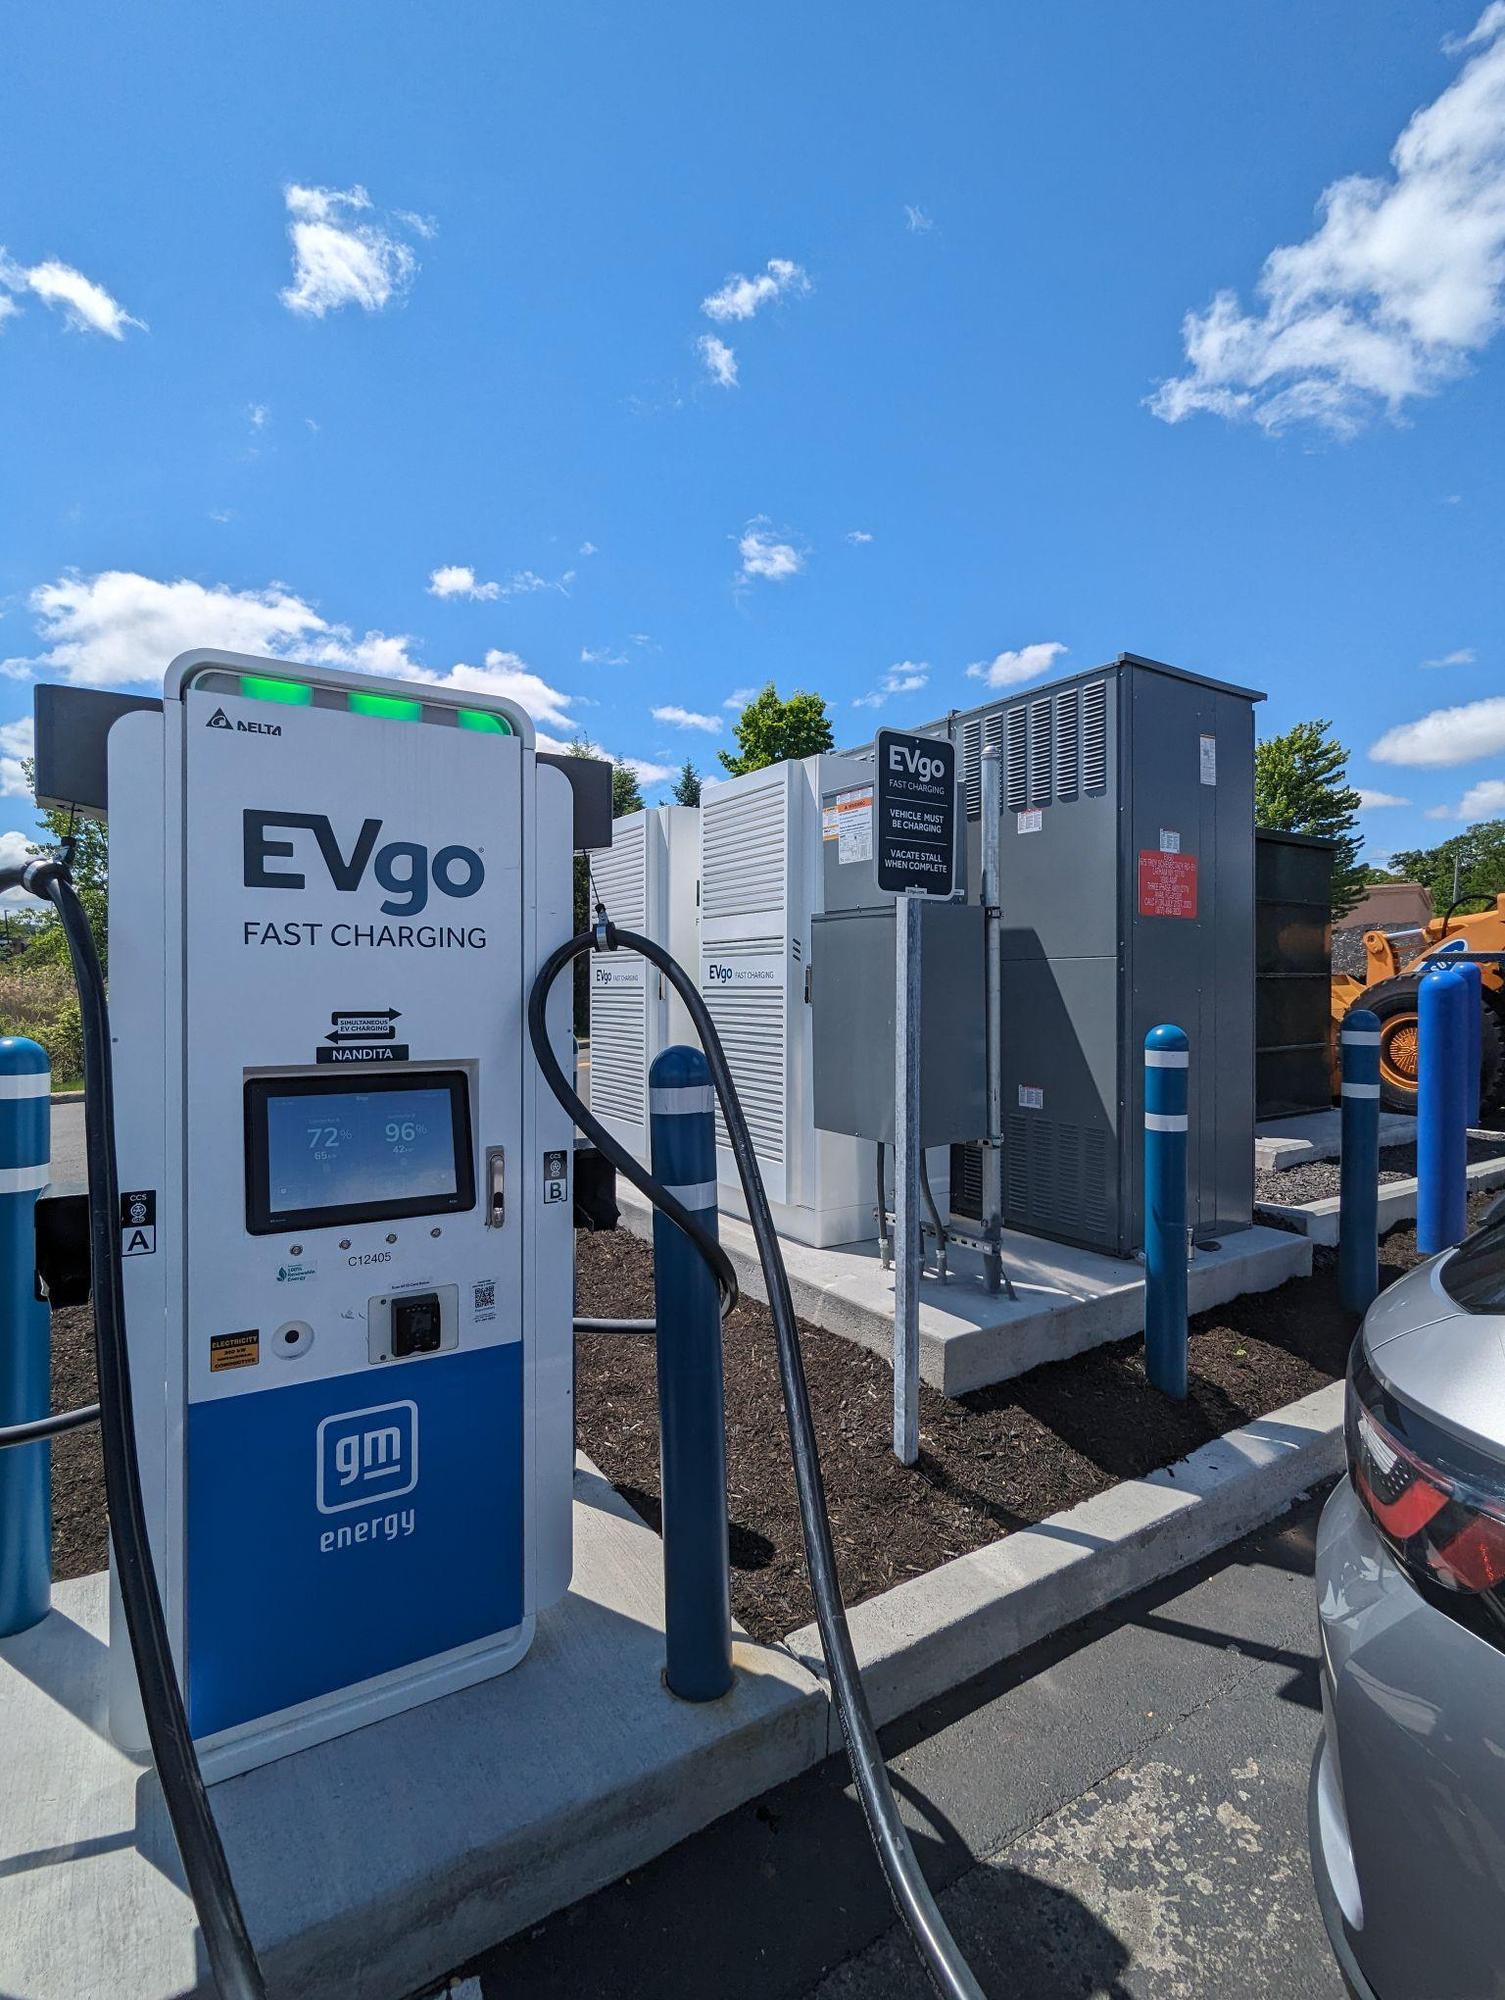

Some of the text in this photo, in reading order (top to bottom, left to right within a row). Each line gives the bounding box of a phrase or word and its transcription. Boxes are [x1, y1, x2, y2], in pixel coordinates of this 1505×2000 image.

[237, 720, 282, 737] DELTA
[888, 744, 945, 782] EVgo
[889, 778, 945, 795] FAST CHARGING
[889, 808, 944, 824] VEHICLE MUST
[892, 819, 942, 834] BE CHARGING
[243, 808, 485, 917] EVgo
[890, 849, 942, 863] VACATE STALL
[885, 858, 948, 873] WHEN COMPLETE
[243, 922, 487, 948] FAST CHARGING
[596, 969, 612, 984] EVgo
[709, 964, 733, 983] EVgo
[350, 1024, 388, 1032] CHARGING
[332, 1048, 393, 1061] NANDITA
[130, 1194, 147, 1202] CCS
[550, 1182, 562, 1199] B
[127, 1230, 150, 1252] A
[349, 1252, 391, 1266] C12405
[212, 1335, 258, 1349] ELECTRICITY
[335, 1426, 401, 1486] gm
[320, 1508, 415, 1553] energy
